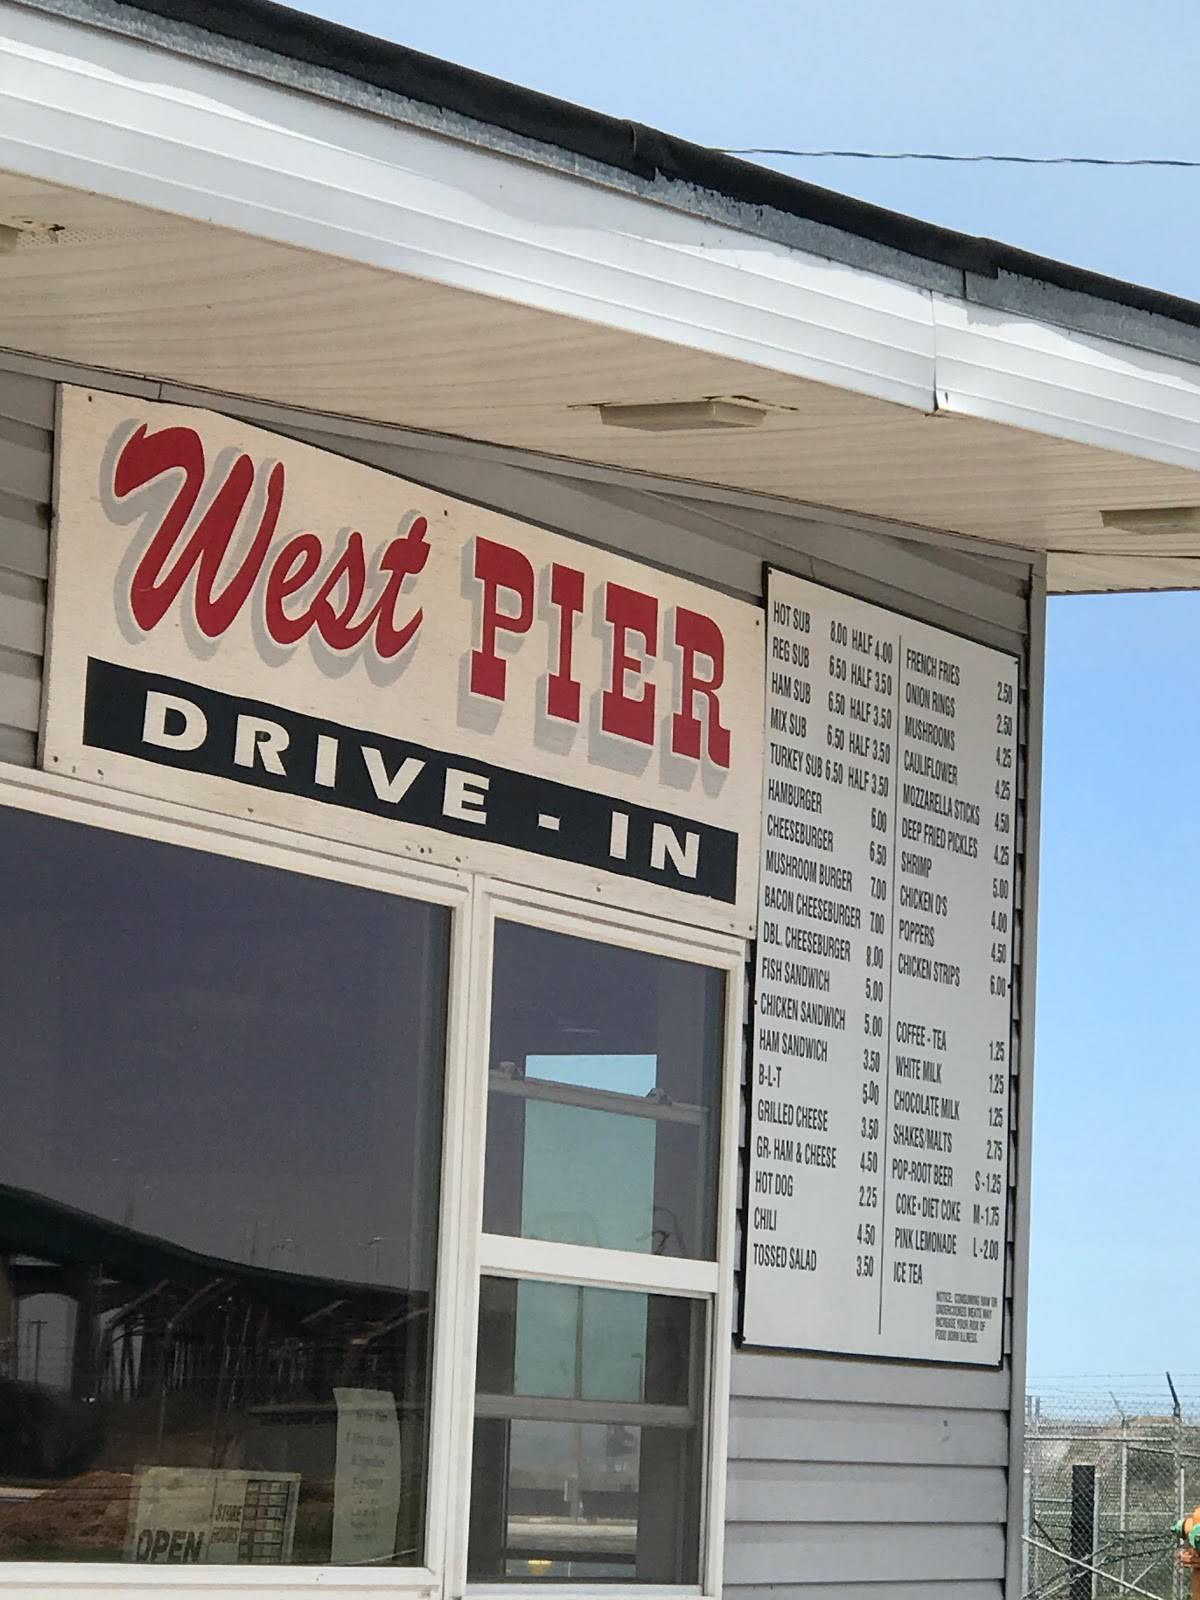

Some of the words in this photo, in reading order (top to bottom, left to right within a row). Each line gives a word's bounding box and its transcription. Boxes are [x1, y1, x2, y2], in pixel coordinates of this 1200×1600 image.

[115, 423, 431, 659] West
[470, 536, 731, 769] PIER
[773, 601, 791, 626] HOT
[792, 608, 810, 633] SUB
[830, 621, 847, 646] 8.00
[851, 629, 873, 654] HALF
[874, 640, 892, 664] 4.00
[772, 637, 790, 662] REG
[791, 643, 809, 668] SUB
[828, 655, 846, 681] 6.50
[850, 664, 872, 688] HALF
[874, 672, 892, 696] 3.50
[906, 648, 937, 677] FRENCH
[938, 660, 960, 686] FRIES
[996, 681, 1012, 704] 2.50
[771, 672, 791, 698] HAM
[793, 679, 811, 704] SUB
[828, 691, 845, 715] 6.50
[849, 698, 871, 722] HALF
[872, 705, 892, 729] 3.50
[905, 682, 930, 709] ONION
[931, 692, 955, 718] RINGS
[996, 714, 1012, 736] 2.50
[770, 707, 787, 732] MIX
[788, 713, 806, 738] SUB
[826, 724, 844, 750] 6.50
[848, 732, 870, 757] HALF
[871, 739, 890, 764] 3.50
[904, 715, 955, 751] MUSHROOMS
[995, 746, 1011, 768] 4.25
[769, 742, 803, 772] TURKEY
[805, 753, 822, 778] SUB
[825, 760, 843, 784] 6.50
[847, 767, 869, 791] HALF
[870, 773, 888, 797] 3.50
[903, 750, 957, 785] CAULIFLOWER
[994, 780, 1010, 800] 4.25
[767, 779, 822, 814] HAMBURGER
[870, 808, 887, 833] 6.00
[902, 783, 952, 817] MOZZARELLA
[954, 799, 980, 825] STICKS
[994, 812, 1009, 833] 4.50
[766, 814, 833, 852] CHEESEBURGER
[869, 841, 886, 866] 6.50
[901, 817, 922, 841] DEEP
[923, 824, 946, 848] FRIED
[947, 831, 978, 858] PICKLES
[993, 845, 1008, 865] 4.25
[765, 849, 817, 883] MUSHROOM
[818, 864, 852, 892] BURGER
[870, 876, 886, 901] 7.00
[900, 851, 932, 878] SHRIMP
[992, 878, 1008, 899] 5.00
[764, 885, 794, 912] BACON
[795, 893, 861, 929] CHEESEBURGER
[869, 911, 884, 935] 7.00
[899, 885, 933, 913] CHICKEN
[990, 911, 1006, 933] 4.00
[784, 926, 850, 962] CHEESEBURGER
[865, 946, 883, 969] 8.00
[898, 919, 934, 947] POPPERS
[990, 943, 1005, 963] 4.50
[762, 958, 782, 981] FISH
[784, 962, 830, 992] SANDWICH
[865, 978, 883, 1002] 5.00
[897, 953, 932, 980] CHICKEN
[932, 961, 960, 987] STRIPS
[989, 975, 1005, 997] 6.00
[760, 993, 798, 1021] CHICKEN
[800, 1001, 845, 1030] SANDWICH
[863, 1013, 882, 1037] 5.00
[759, 1030, 779, 1053] HAM
[781, 1033, 827, 1062] SANDWICH
[862, 1049, 880, 1072] 3.50
[895, 1021, 925, 1047] COFFEE
[931, 1029, 946, 1051] TEA
[988, 1041, 1004, 1061] 1.25
[895, 1056, 921, 1080] WHITE
[922, 1061, 942, 1083] MILK
[988, 1074, 1003, 1094] 1.25
[757, 1099, 794, 1126] GRILLED
[795, 1105, 828, 1131] CHEESE
[860, 1117, 878, 1140] 3.50
[893, 1089, 939, 1117] CHOCOLATE
[940, 1098, 960, 1120] MILK
[988, 1107, 1002, 1127] 1.25
[773, 1138, 793, 1162] HAM
[795, 1142, 802, 1163] &
[804, 1143, 836, 1168] CHEESE
[859, 1151, 877, 1173] 4.50
[986, 1140, 1002, 1161] 2.75
[755, 1172, 773, 1194] HOT
[774, 1174, 793, 1197] DOG
[858, 1185, 877, 1208] 2.25
[933, 1164, 953, 1187] BEER
[754, 1207, 777, 1231] CHILI
[856, 1224, 875, 1246] 4.50
[921, 1197, 939, 1218] DIET
[940, 1199, 961, 1222] COKE
[753, 1244, 787, 1268] TOSSED
[788, 1247, 816, 1271] SALAD
[856, 1255, 874, 1277] 3.50
[894, 1227, 913, 1249] PINK
[914, 1230, 956, 1255] LEMONADE
[893, 1261, 906, 1283] ICE
[908, 1263, 922, 1284] TEA
[137, 1529, 205, 1562] OPEN
